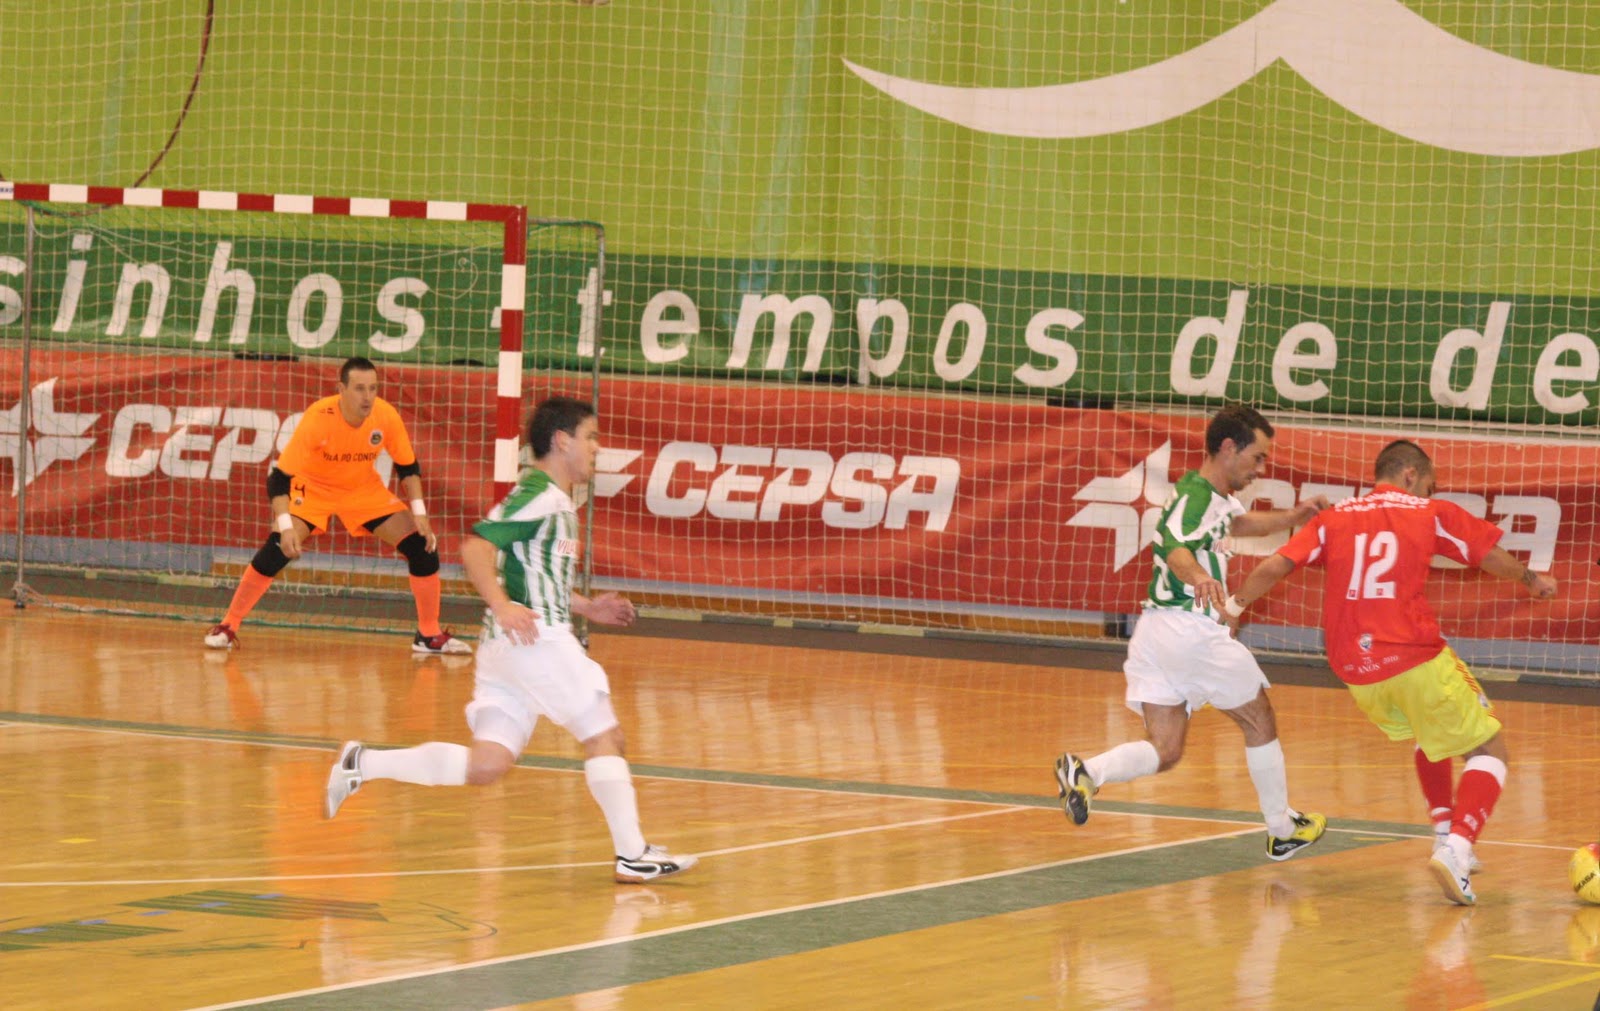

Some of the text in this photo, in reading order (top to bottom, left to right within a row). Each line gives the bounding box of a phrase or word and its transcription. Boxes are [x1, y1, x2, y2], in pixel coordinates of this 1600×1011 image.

[577, 267, 1085, 387] tempos
[1170, 290, 1337, 401] de
[1429, 302, 1600, 414] de
[105, 403, 393, 489] CEP
[645, 441, 961, 532] CEPSA
[1346, 531, 1398, 600] 12
